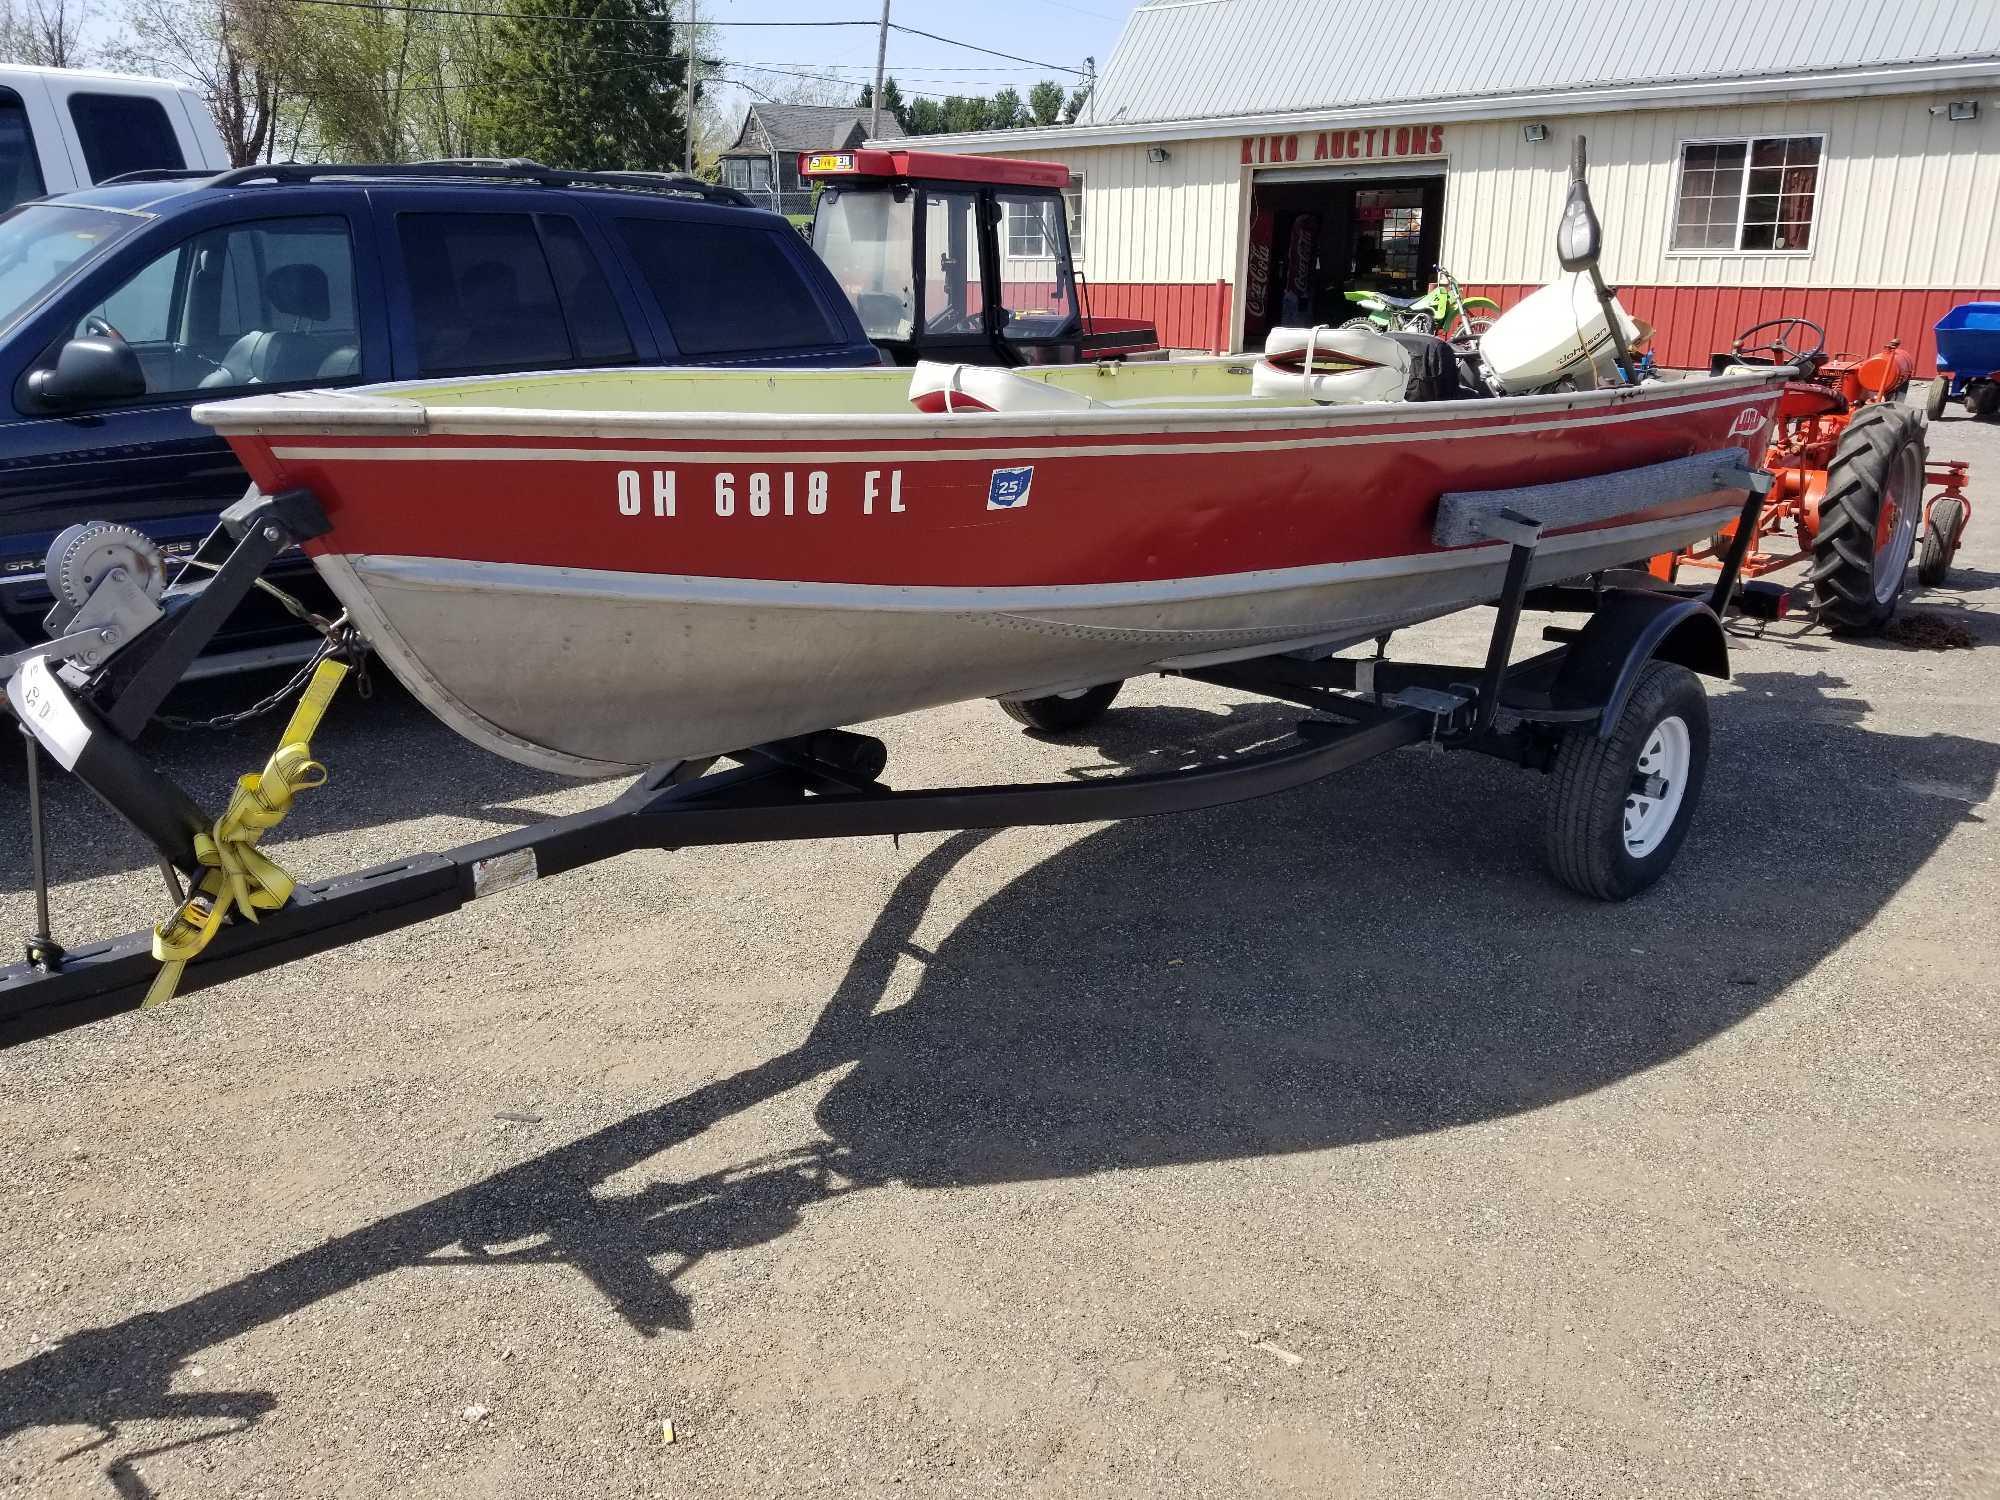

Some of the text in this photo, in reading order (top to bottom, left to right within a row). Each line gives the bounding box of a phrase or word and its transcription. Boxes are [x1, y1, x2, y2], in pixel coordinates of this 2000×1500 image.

[1241, 125, 1445, 164] KIKO AUCTIONS
[617, 470, 906, 517] OH 6818 FL
[999, 480, 1018, 494] 25
[7, 558, 46, 571] GRA
